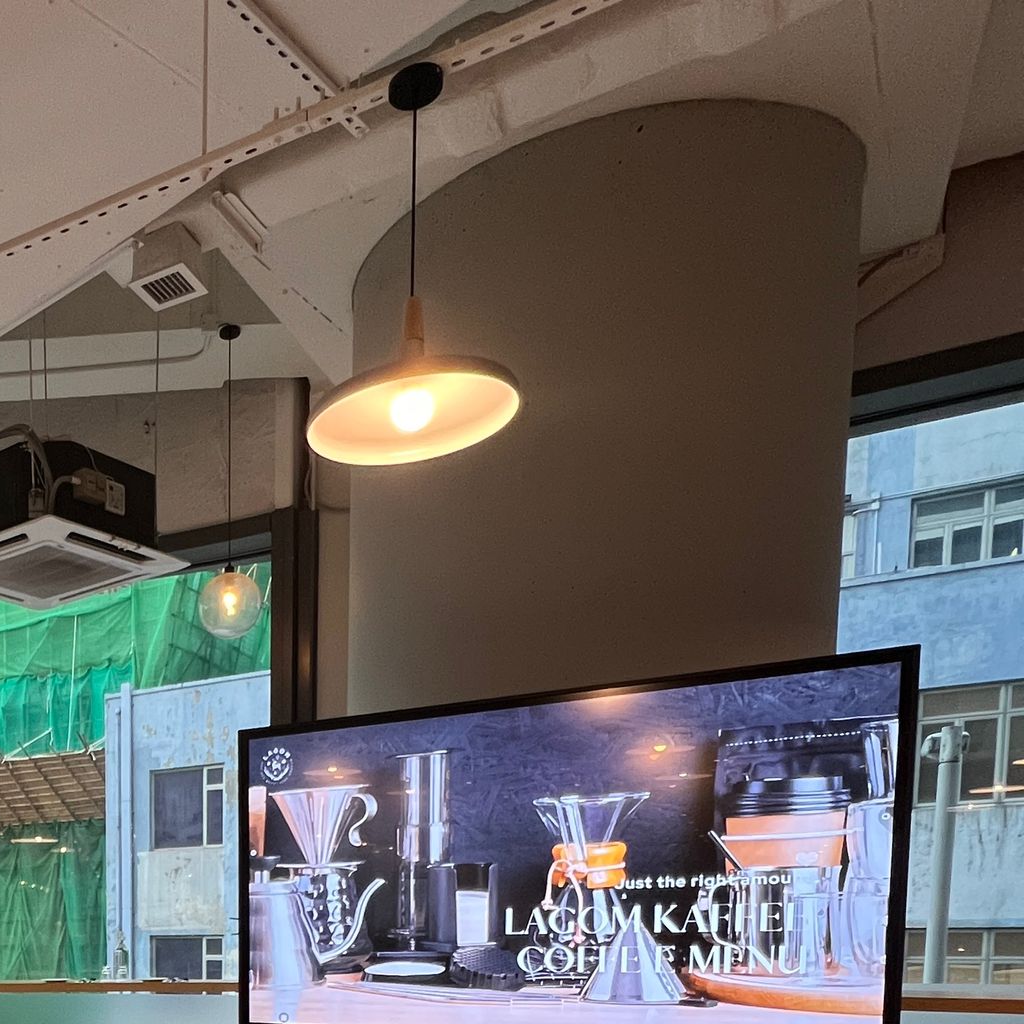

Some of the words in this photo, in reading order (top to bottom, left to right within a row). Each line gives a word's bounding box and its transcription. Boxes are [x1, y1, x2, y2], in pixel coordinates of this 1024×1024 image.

[614, 876, 653, 890] Just
[656, 875, 687, 889] the
[690, 872, 734, 889] right
[504, 903, 641, 936] LAGOM
[653, 902, 807, 934] KAFFEE
[688, 945, 807, 975] MENU
